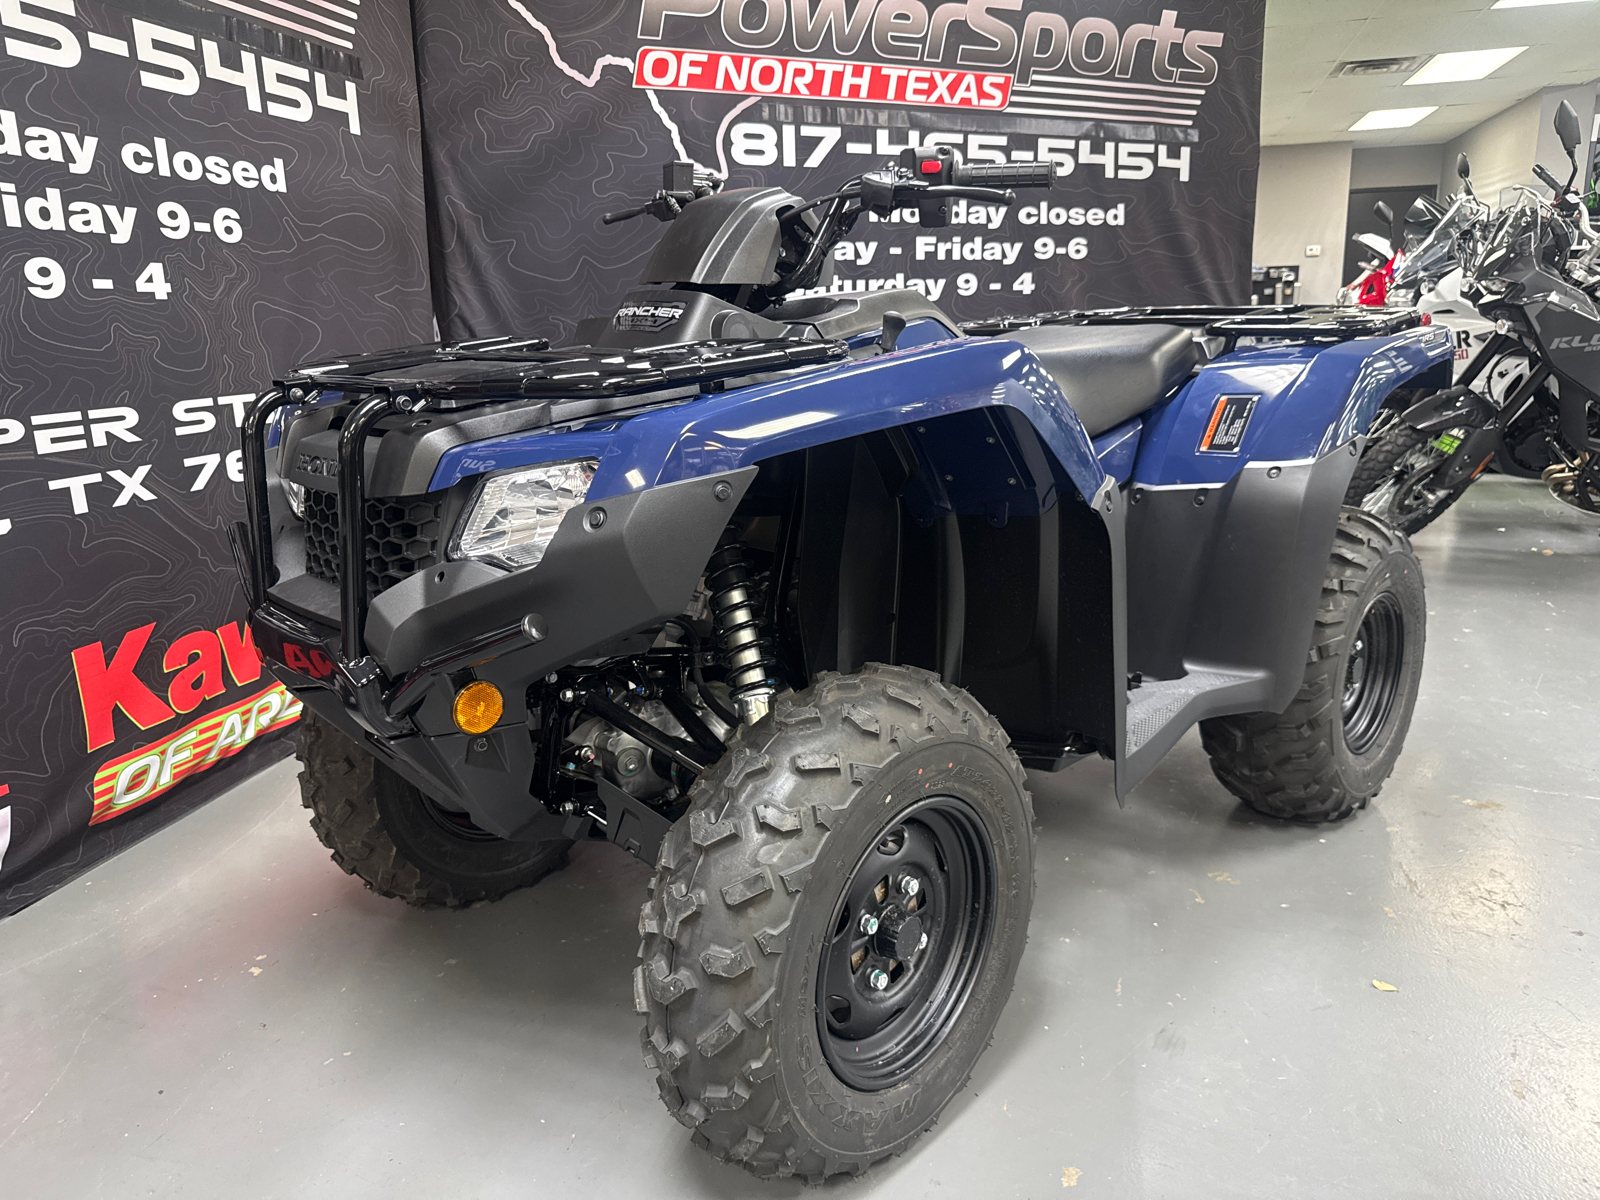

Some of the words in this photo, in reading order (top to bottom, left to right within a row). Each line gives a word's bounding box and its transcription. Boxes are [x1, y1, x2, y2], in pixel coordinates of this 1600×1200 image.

[637, 0, 1224, 88] PowerSports
[0, 0, 362, 136] 5-5454
[641, 50, 709, 89] OF
[715, 57, 874, 98] NORTH
[881, 67, 1007, 109] TEXAS
[0, 109, 99, 175] day
[121, 136, 288, 193] closed
[156, 201, 244, 244] 9-6
[868, 200, 1008, 229] oday
[1018, 201, 1125, 226] closed
[915, 236, 1023, 265] Friday
[1033, 237, 1089, 260] 9-6
[24, 256, 67, 300] 9
[92, 278, 114, 290] -
[135, 262, 172, 300] 4
[785, 273, 946, 302] turday
[956, 274, 978, 297] 9
[1012, 272, 1036, 295] 4
[615, 306, 684, 319] RANCHER
[48, 464, 158, 515] TX
[112, 729, 198, 806] OF
